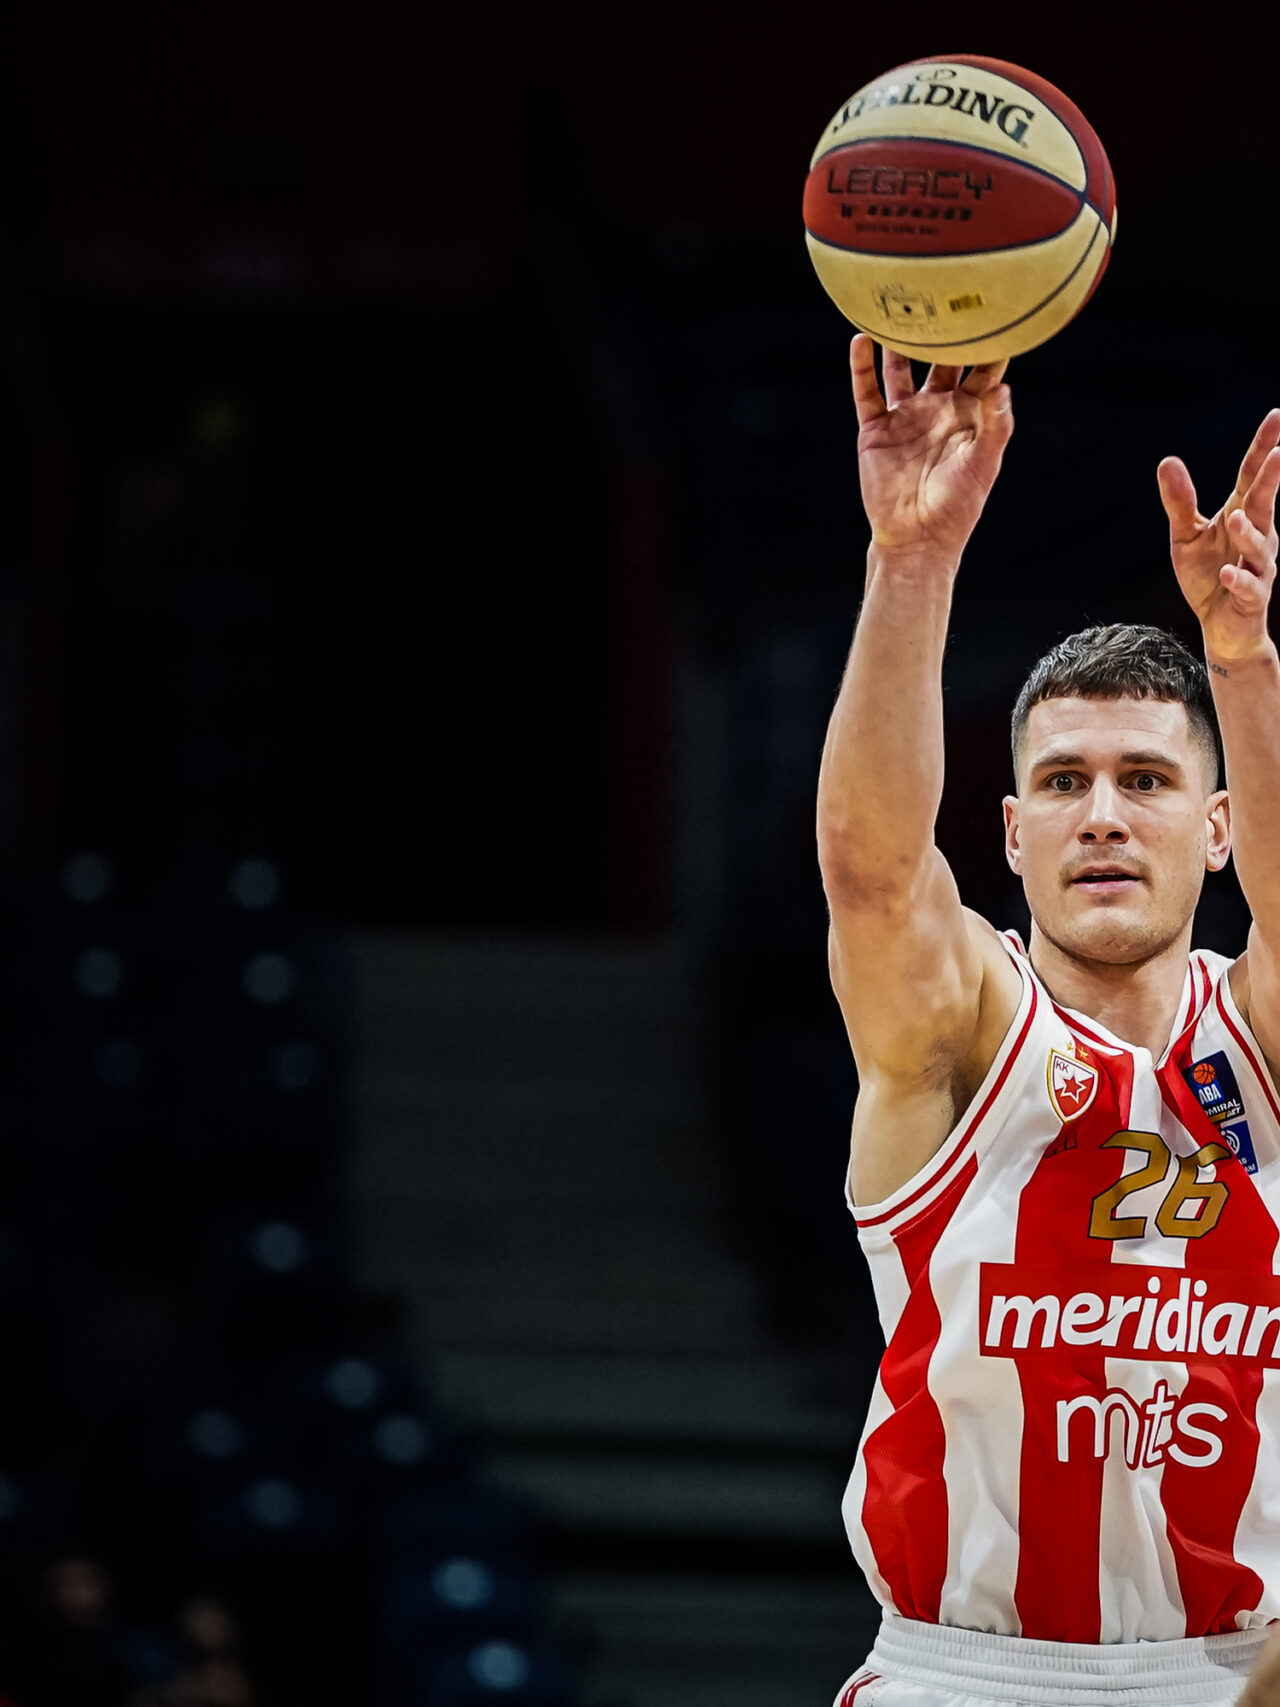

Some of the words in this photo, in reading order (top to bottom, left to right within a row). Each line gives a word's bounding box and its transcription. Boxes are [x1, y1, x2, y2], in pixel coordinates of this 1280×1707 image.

[827, 168, 993, 200] LEGACY
[1198, 1083, 1222, 1105] ABA
[1087, 1129, 1233, 1240] 26
[1056, 1383, 1228, 1468] mts
